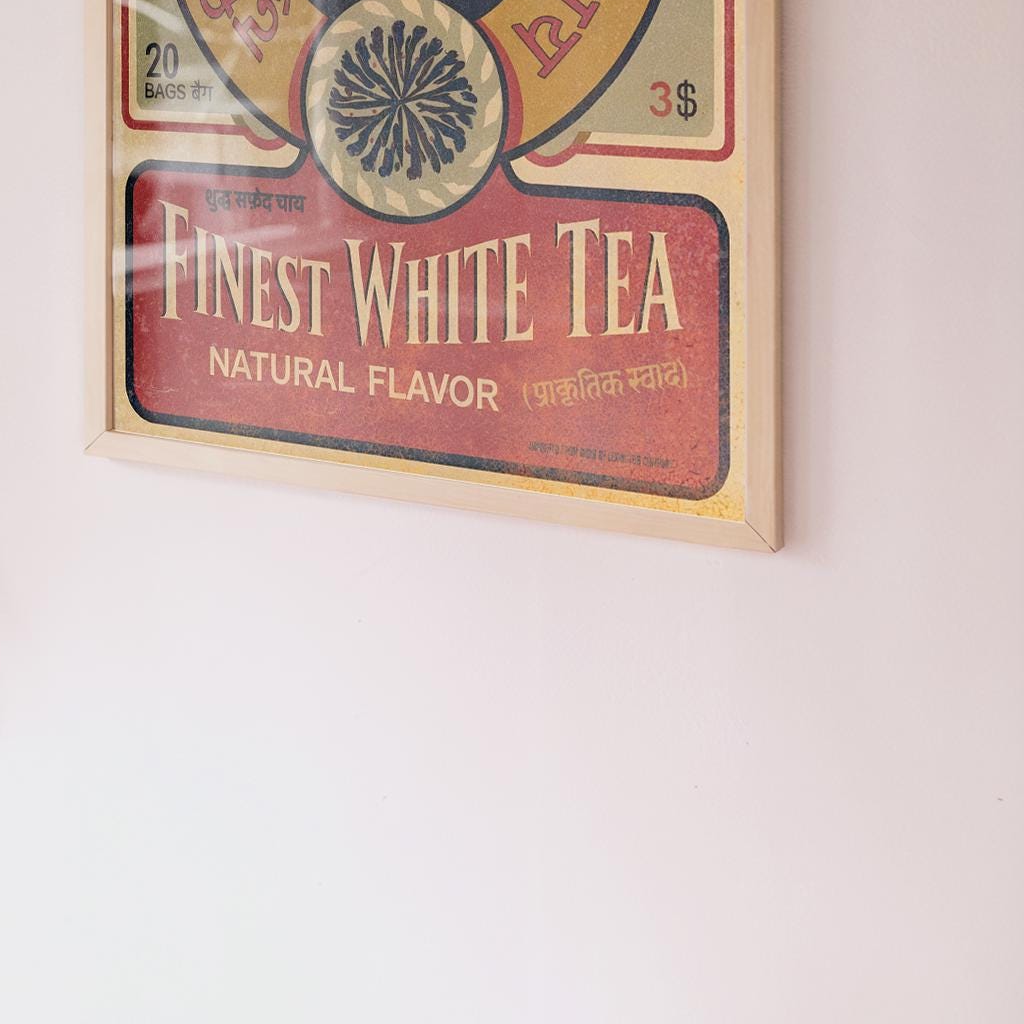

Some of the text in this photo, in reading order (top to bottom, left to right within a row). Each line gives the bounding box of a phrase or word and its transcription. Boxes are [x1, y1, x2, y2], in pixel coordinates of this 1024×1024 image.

[144, 42, 179, 79] 20
[144, 80, 214, 102] BAGS बैग
[649, 79, 698, 122] 3$
[275, 194, 306, 213] चाय
[158, 199, 684, 349] FINEST WHITE TEA
[209, 346, 499, 412] NATURAL FLAVOR
